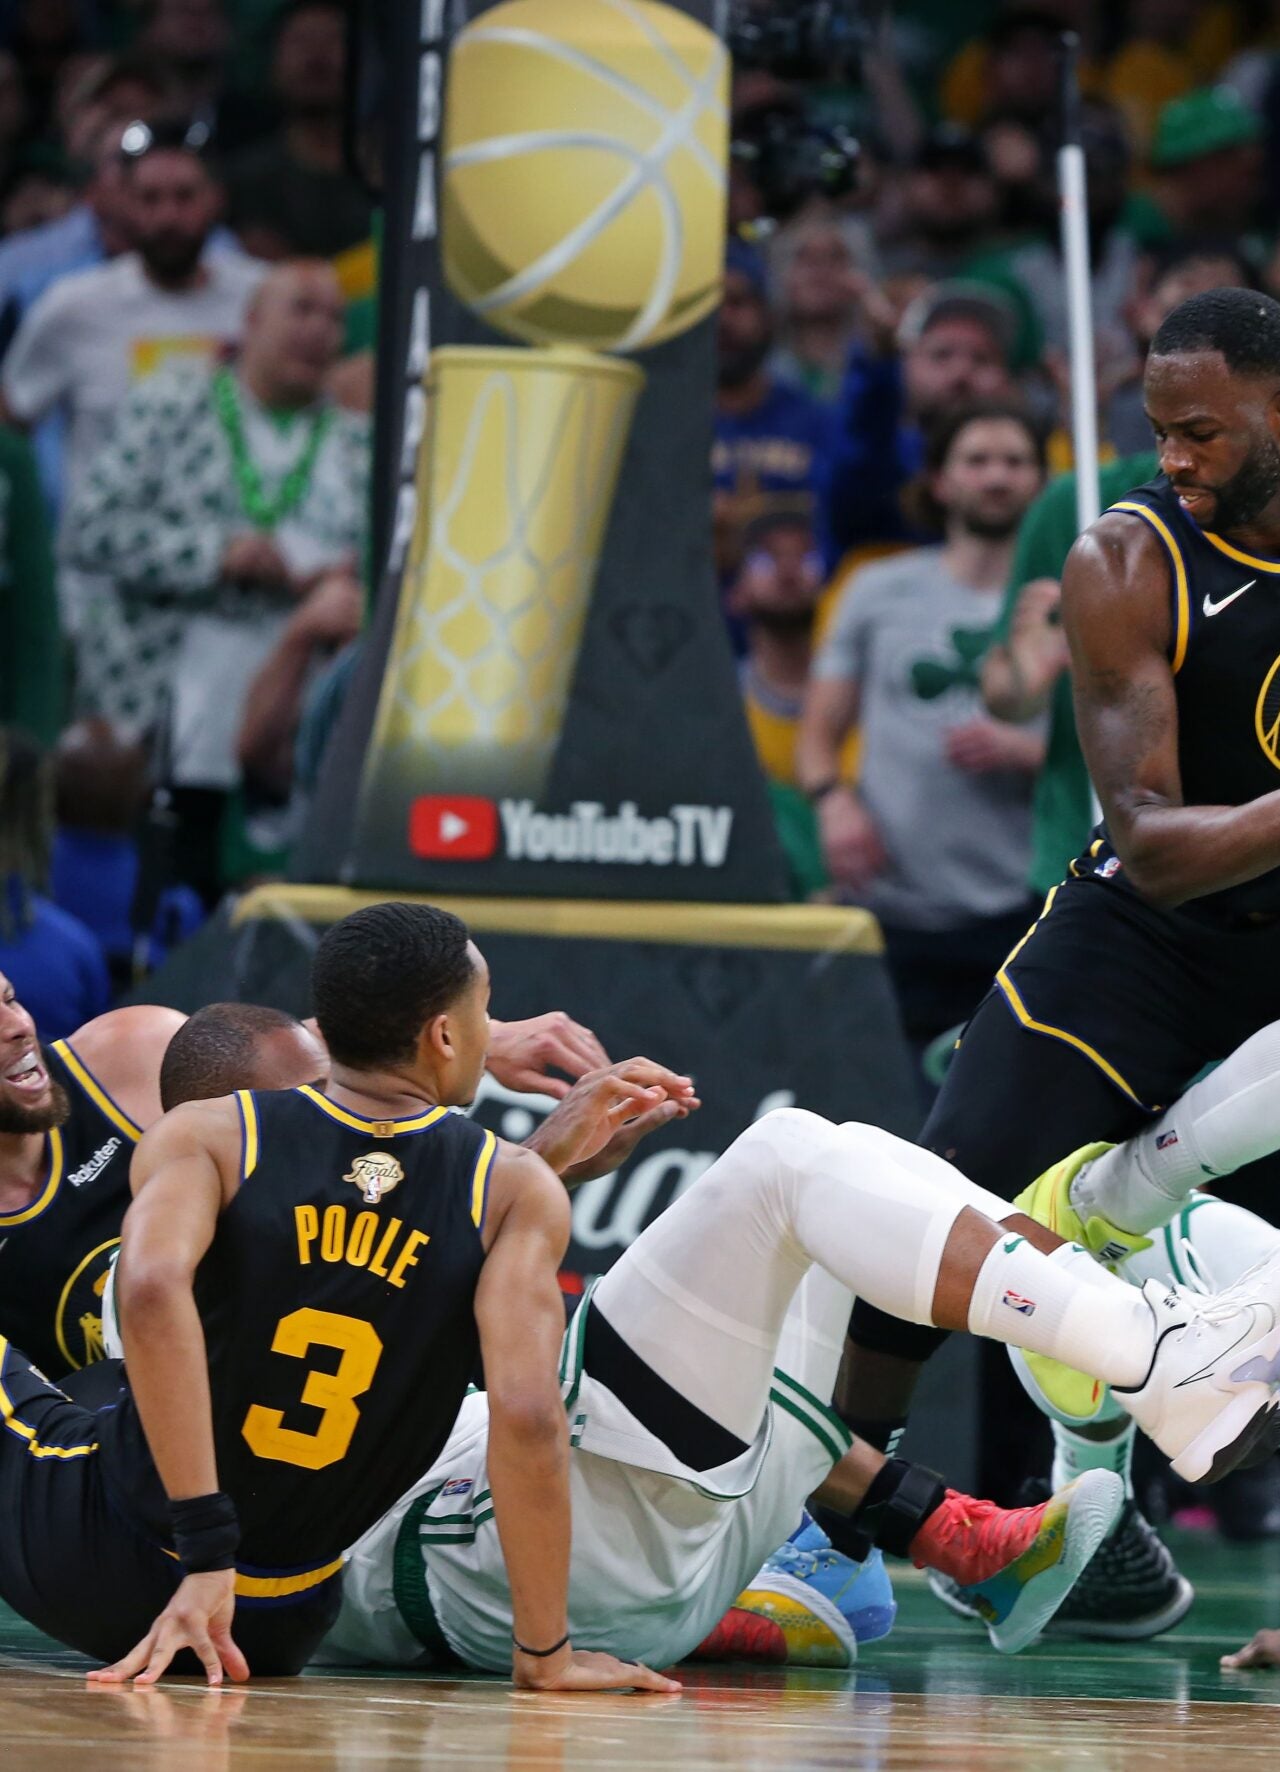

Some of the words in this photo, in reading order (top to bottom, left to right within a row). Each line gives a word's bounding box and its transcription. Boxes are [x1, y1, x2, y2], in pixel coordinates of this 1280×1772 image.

[67, 1136, 122, 1187] Rakuten
[294, 1204, 430, 1289] POOLE
[240, 1306, 384, 1471] 3
